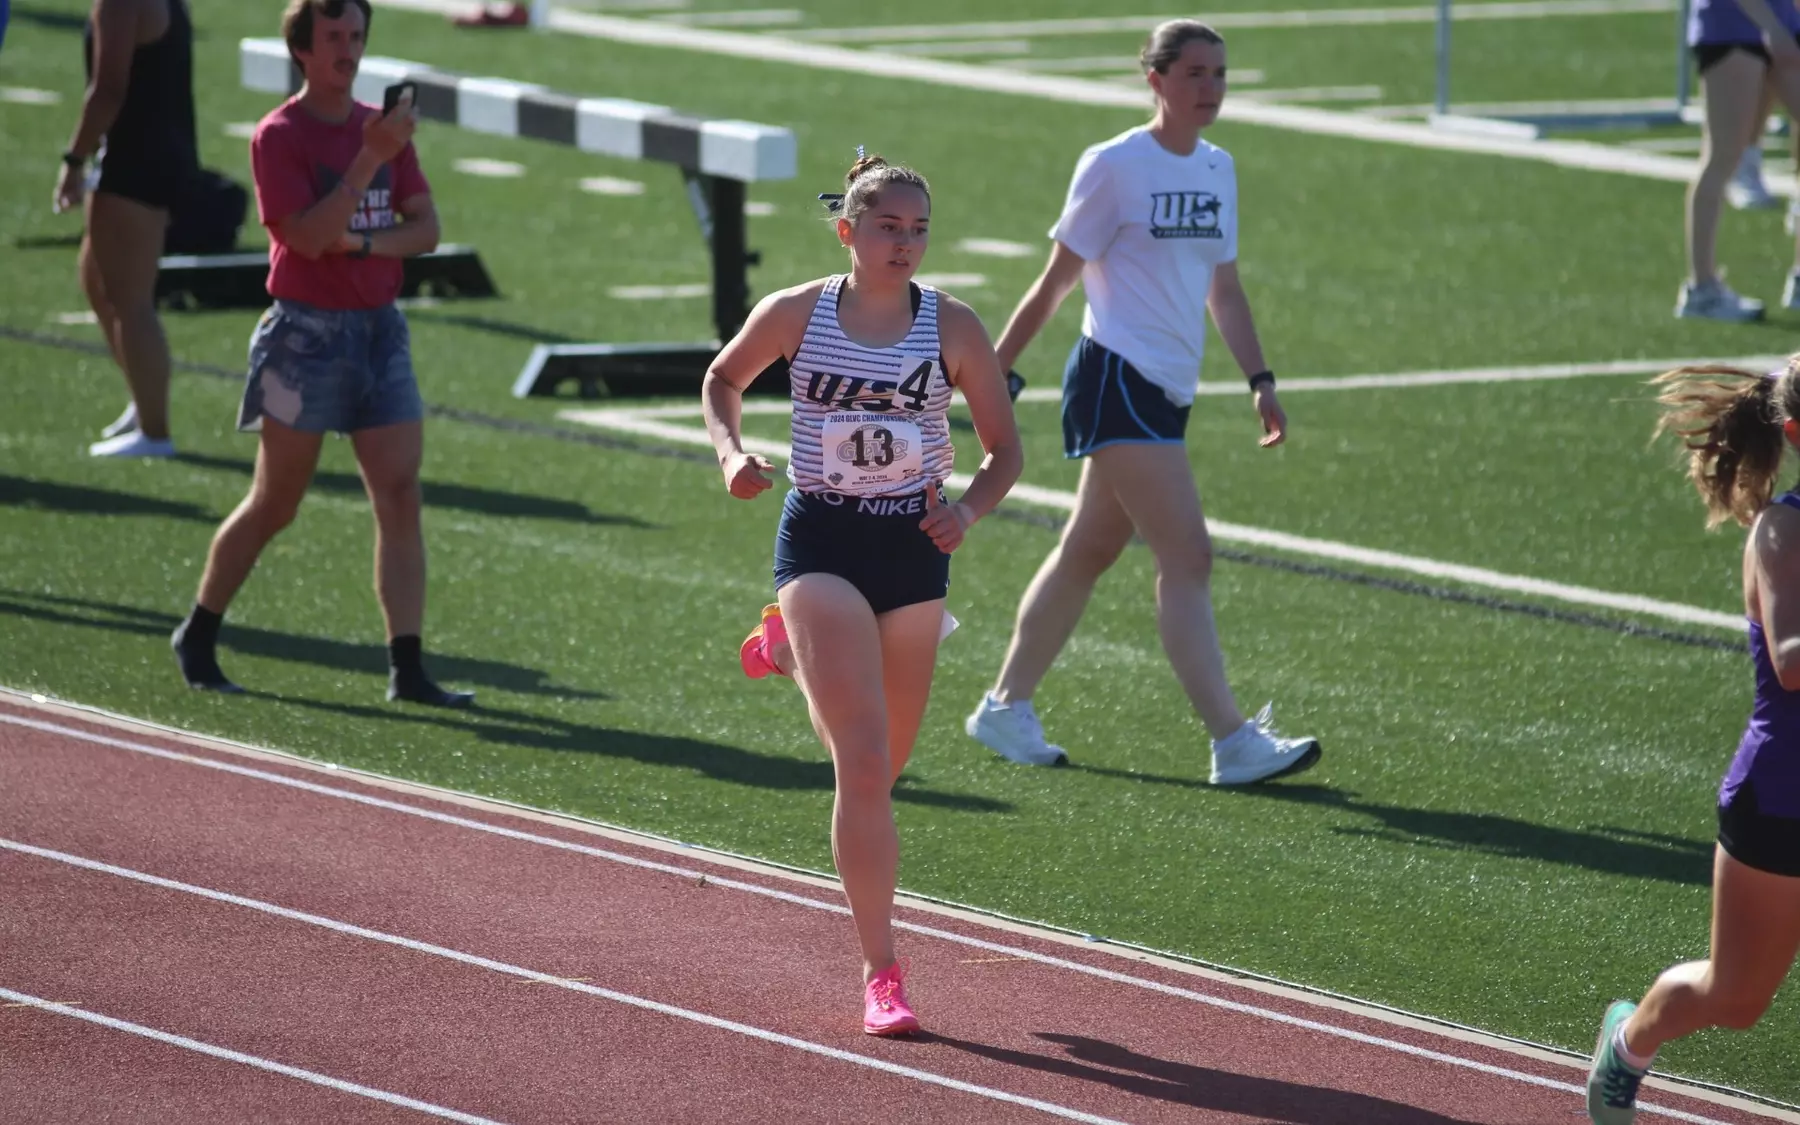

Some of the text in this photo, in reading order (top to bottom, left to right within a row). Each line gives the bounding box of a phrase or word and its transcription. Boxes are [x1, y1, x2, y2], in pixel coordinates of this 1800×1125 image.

[1151, 191, 1220, 229] UIS
[898, 360, 932, 412] 4
[830, 415, 845, 423] 2024
[845, 414, 861, 423] GLVC
[850, 429, 894, 466] 13
[857, 496, 923, 515] NIKE
